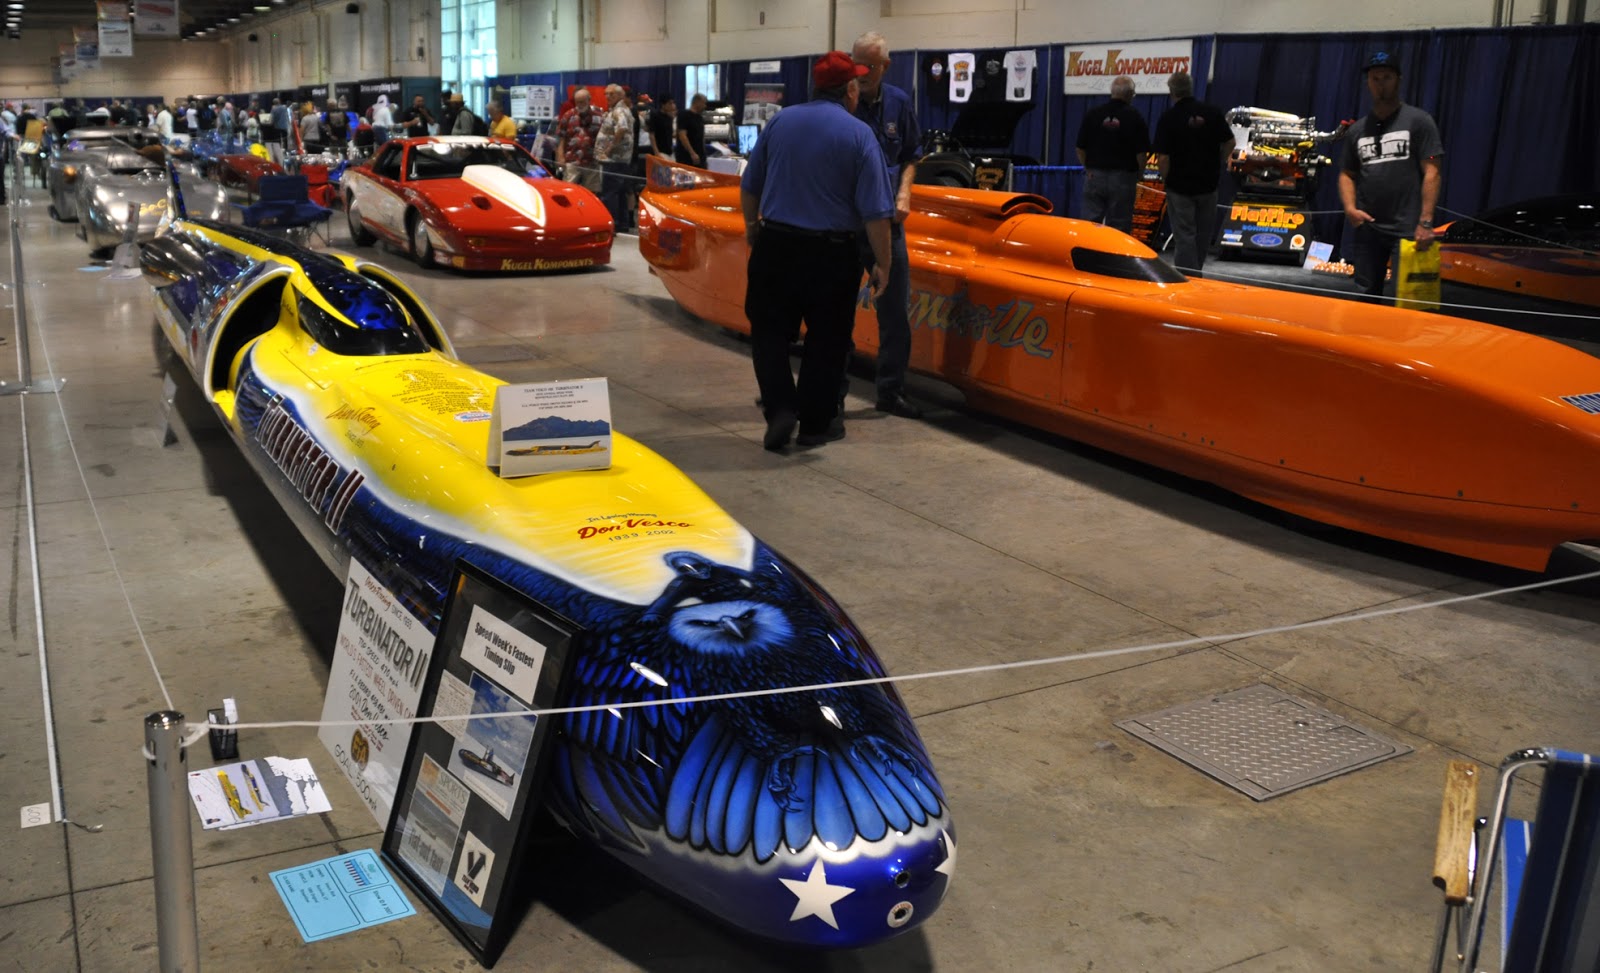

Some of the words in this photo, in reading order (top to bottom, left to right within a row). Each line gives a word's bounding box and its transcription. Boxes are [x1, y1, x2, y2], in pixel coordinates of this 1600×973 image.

[1066, 51, 1103, 76] KUGEL
[1104, 49, 1190, 76] KOMPONENTS
[501, 258, 532, 270] KUGEL
[533, 257, 594, 270] KOMPONENTS
[255, 392, 339, 515] TURBINATOR
[577, 526, 622, 540] Don
[621, 518, 694, 528] Vesco
[345, 577, 414, 678] TURBINATOR
[475, 622, 493, 641] Speed
[492, 633, 512, 654] Week's
[512, 646, 534, 668] Fastest
[484, 646, 503, 667] Timing
[503, 659, 515, 675] Slip
